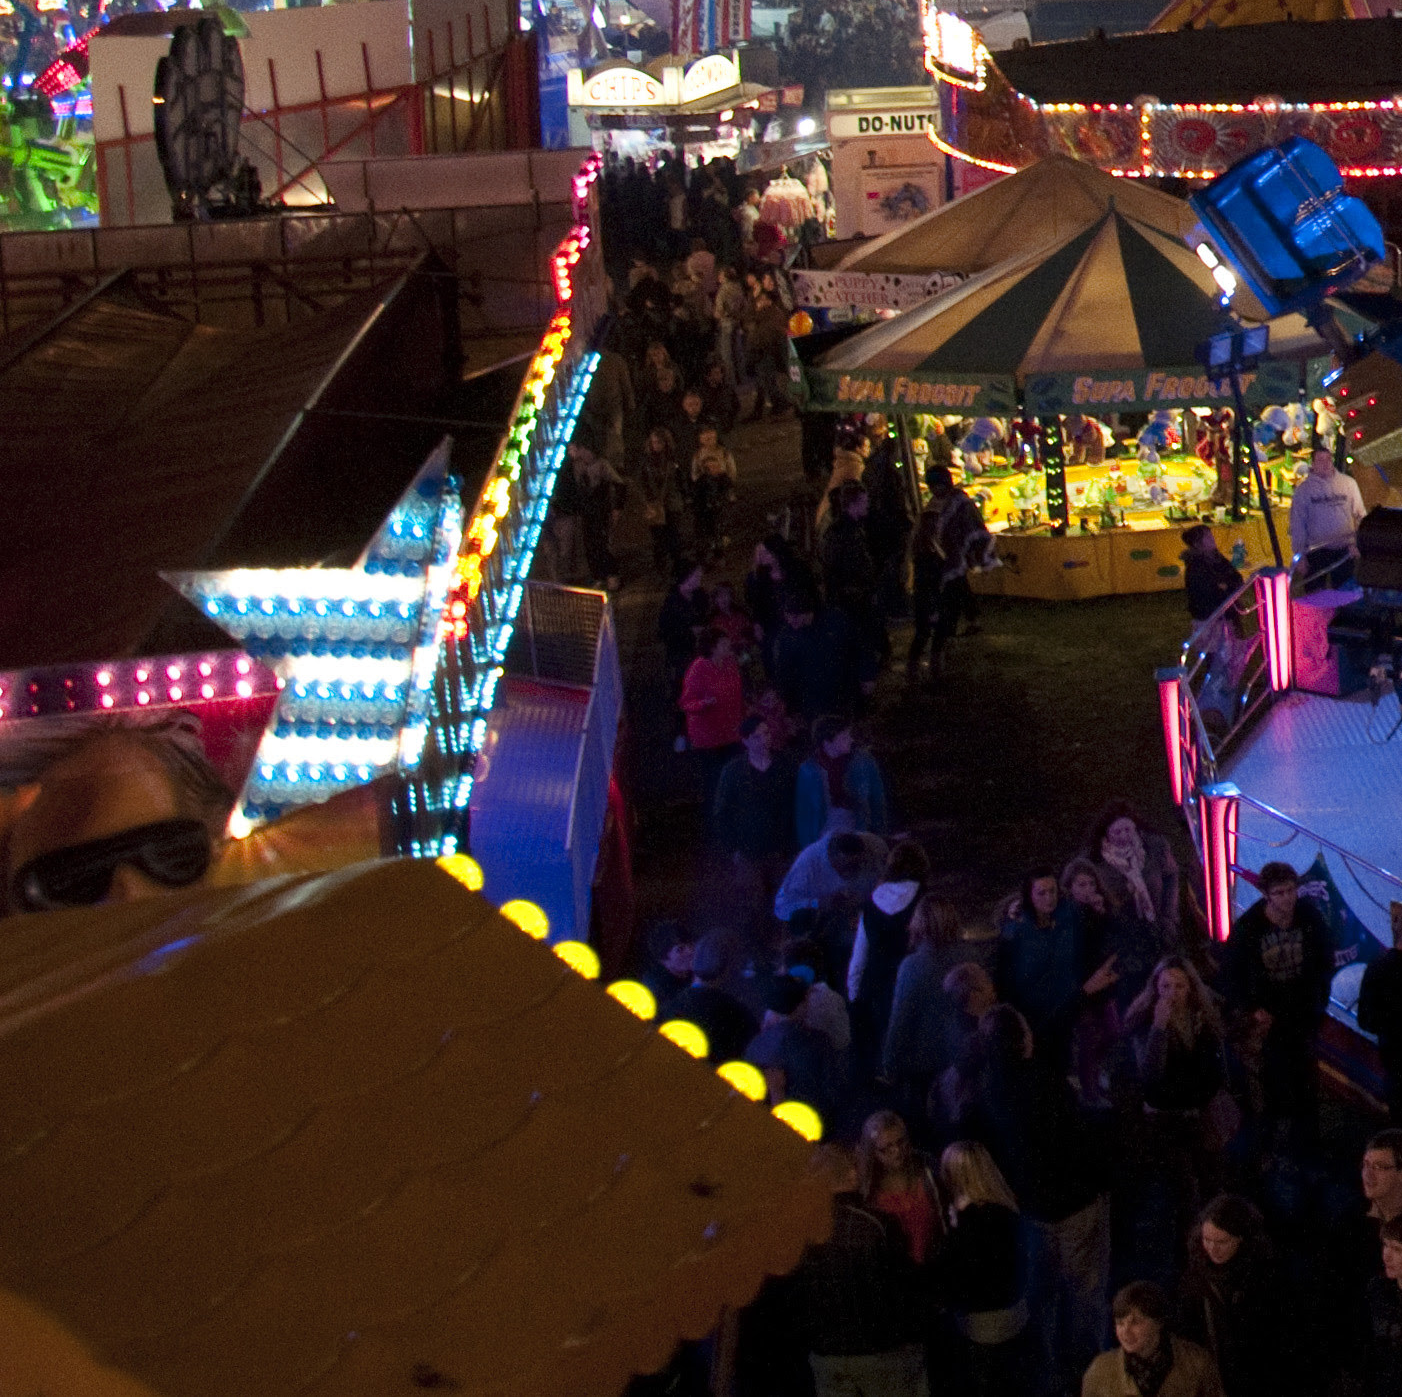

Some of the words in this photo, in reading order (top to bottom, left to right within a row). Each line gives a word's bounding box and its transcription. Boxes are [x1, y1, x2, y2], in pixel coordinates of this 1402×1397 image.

[590, 74, 657, 100] CHIPS
[1072, 376, 1137, 403] SUPA
[1144, 371, 1257, 400] FROGGT
